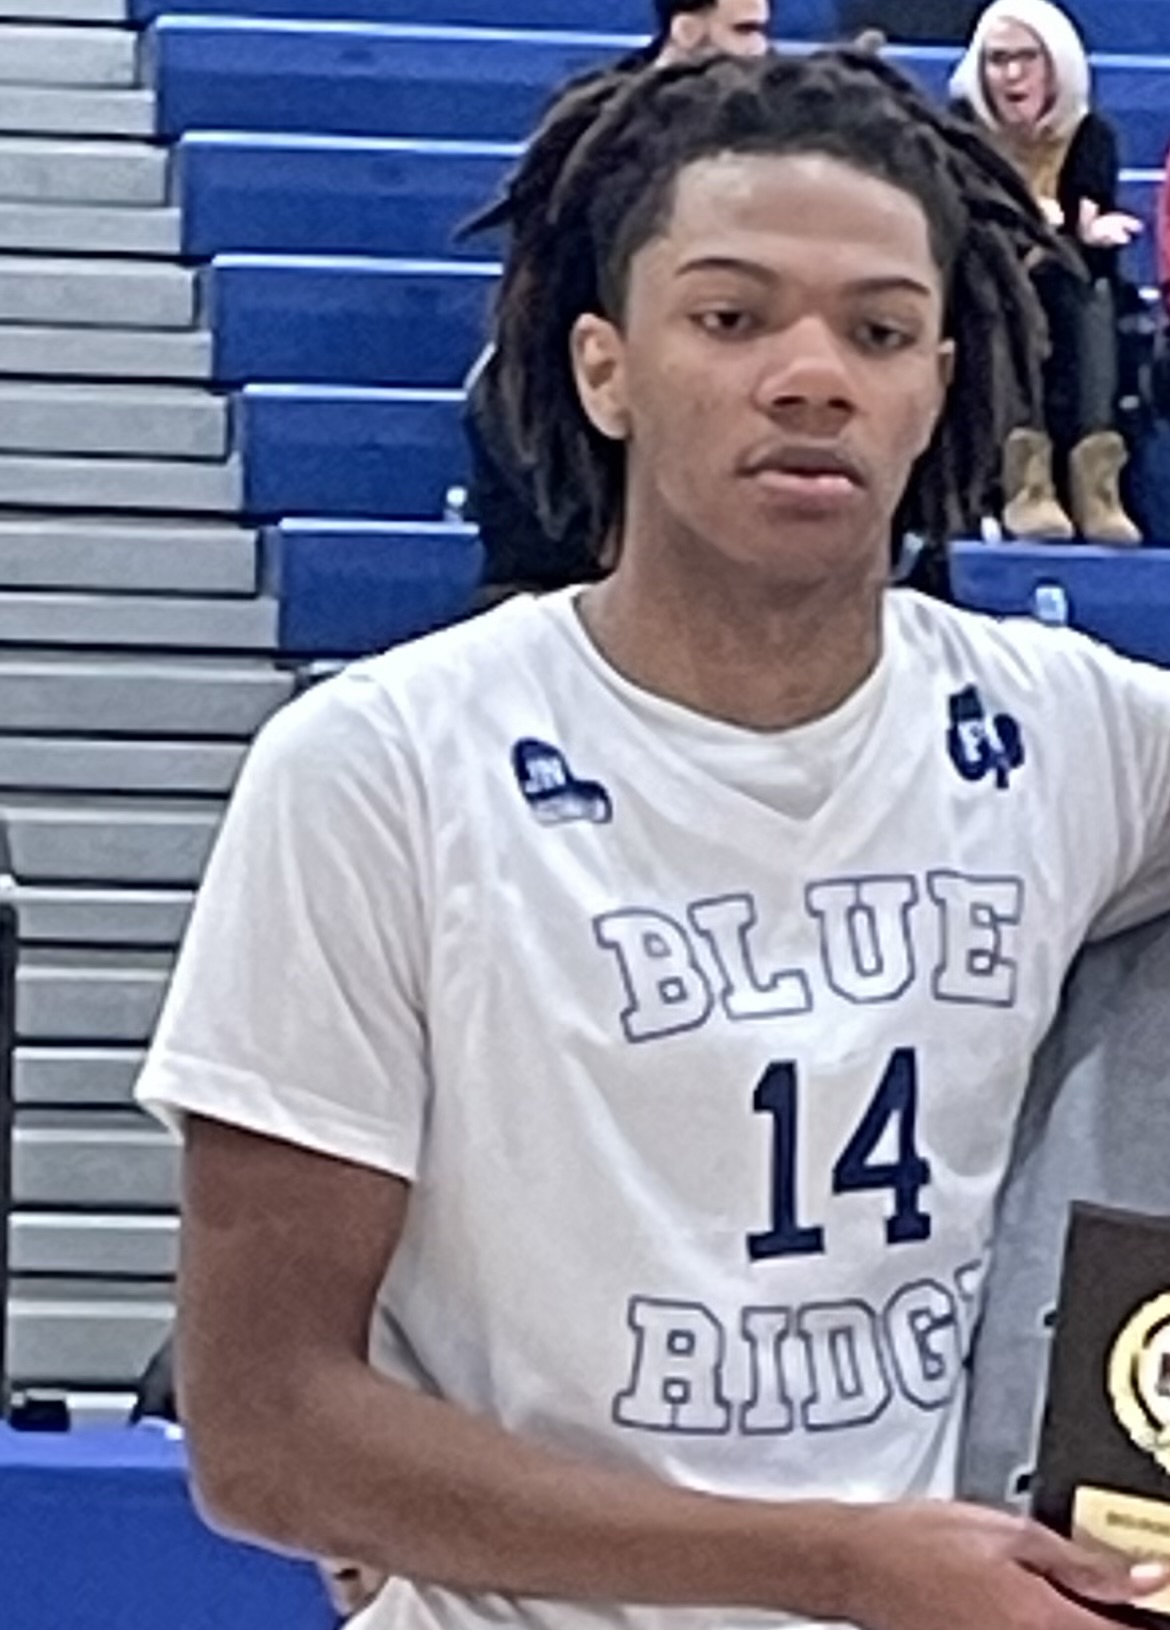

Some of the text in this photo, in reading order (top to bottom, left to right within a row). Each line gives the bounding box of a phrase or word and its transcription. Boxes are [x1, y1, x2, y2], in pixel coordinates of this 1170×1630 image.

[593, 870, 1024, 1043] BLUE
[746, 1046, 931, 1262] 14
[612, 1259, 986, 1436] RIDG
